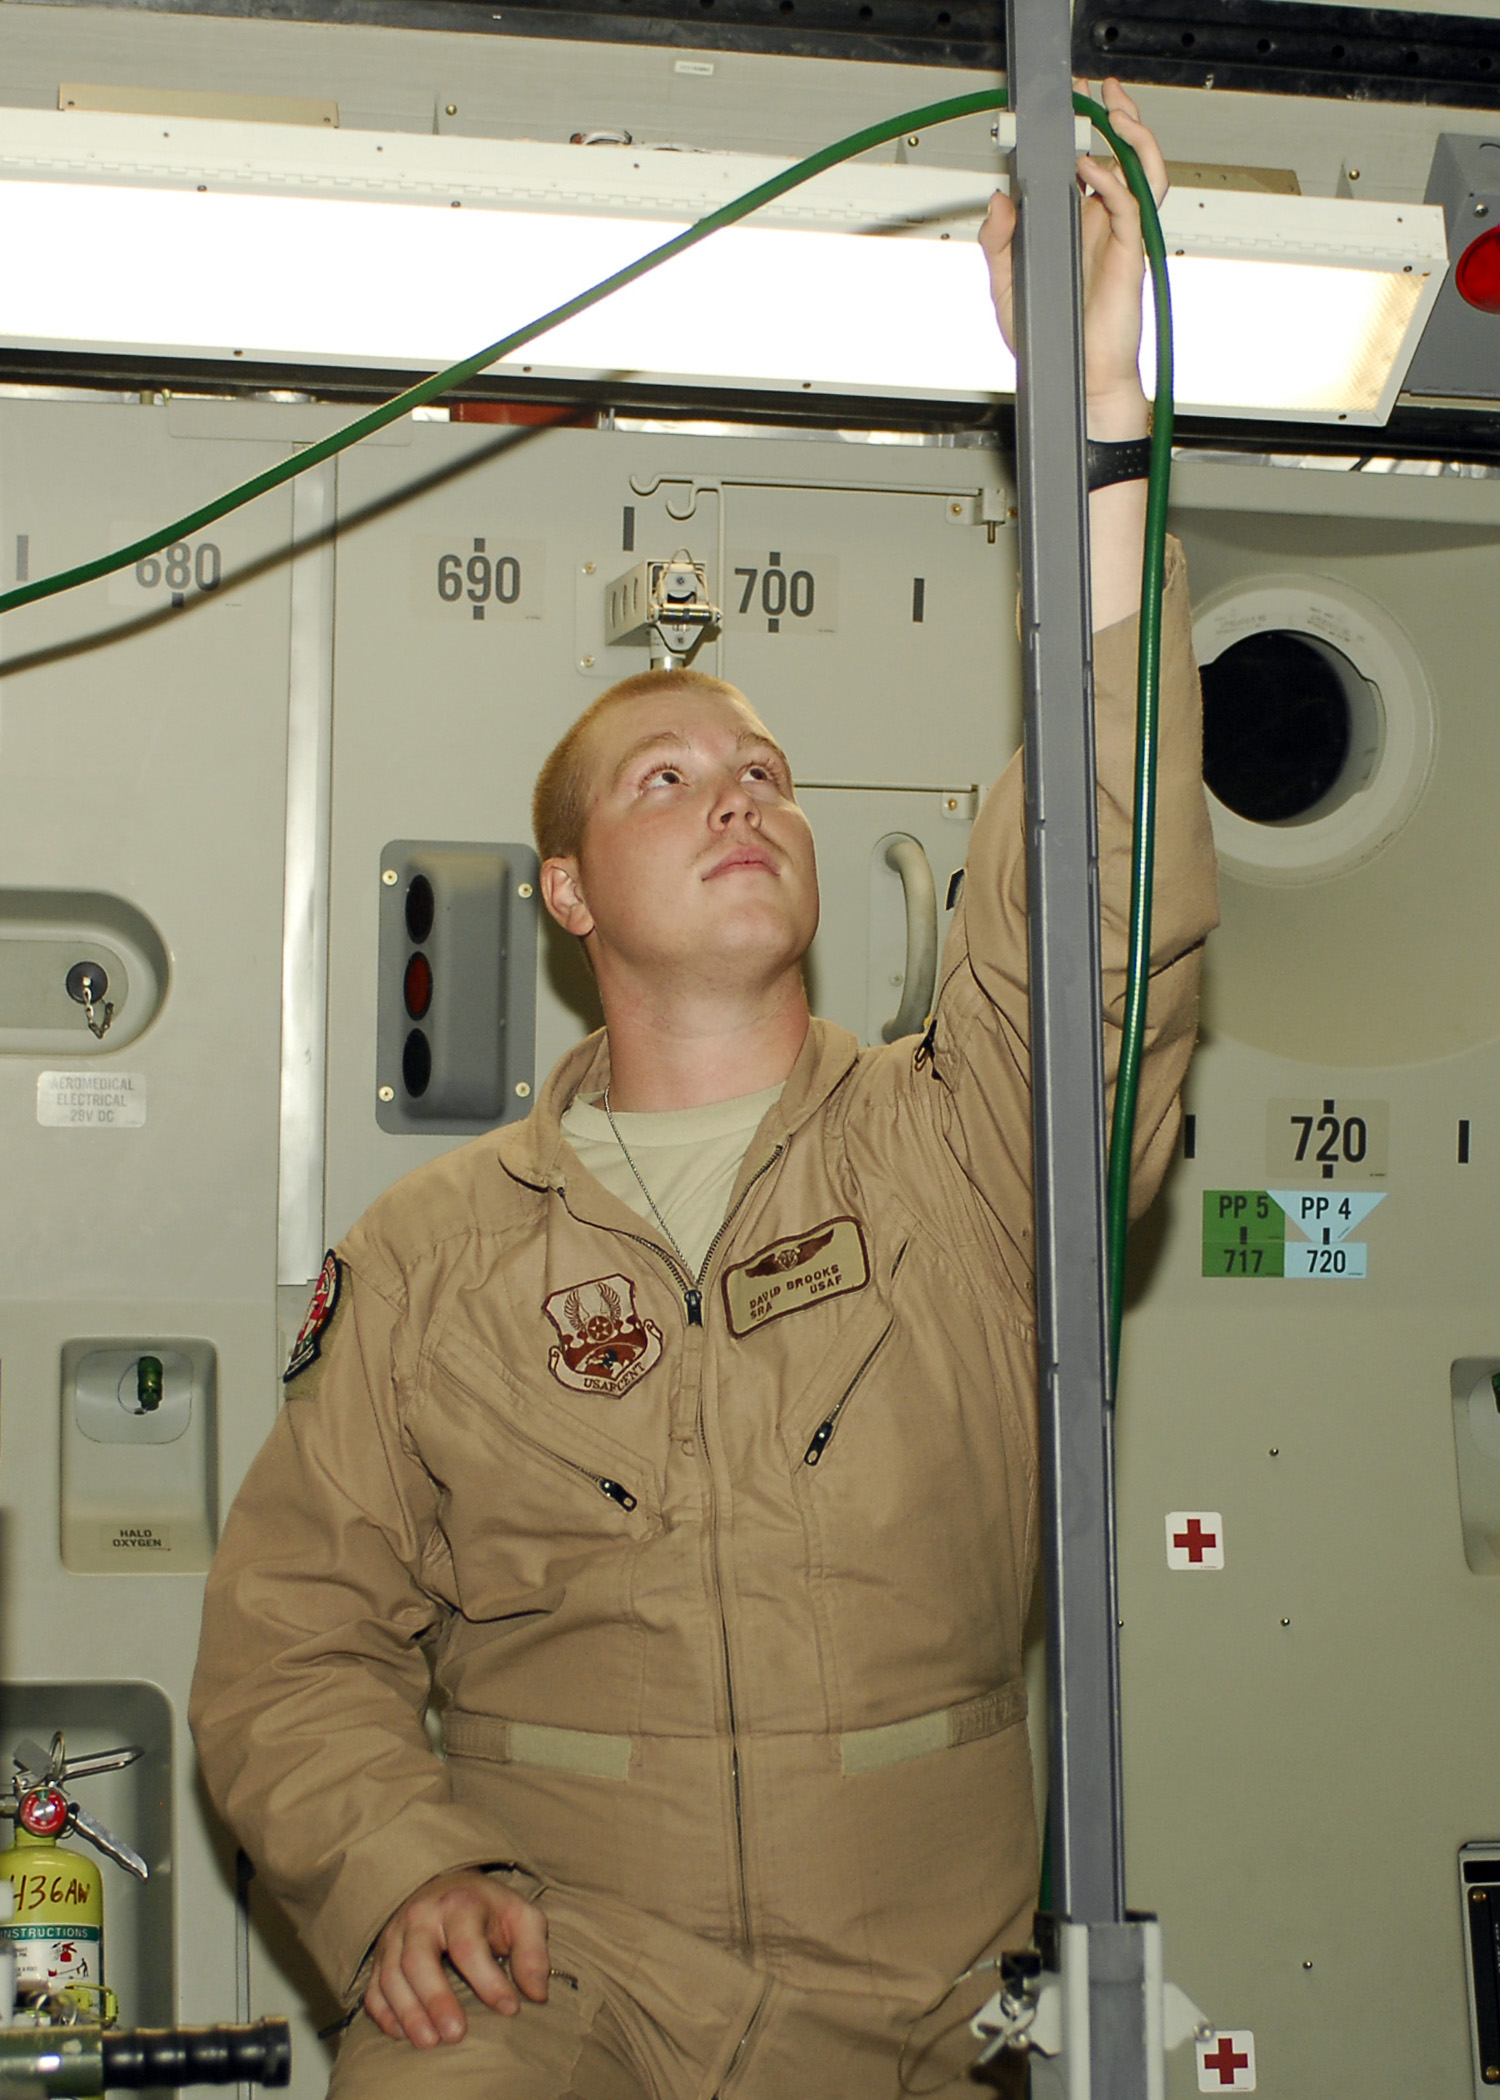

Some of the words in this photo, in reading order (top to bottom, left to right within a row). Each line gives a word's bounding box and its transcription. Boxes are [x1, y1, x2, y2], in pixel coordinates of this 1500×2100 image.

[135, 542, 221, 591] 680
[438, 554, 521, 604] 690
[734, 567, 815, 618] 700
[51, 1077, 135, 1091] AEROMEDICAL
[57, 1093, 127, 1107] ELECTRICAL
[70, 1110, 94, 1122] 28V
[98, 1110, 114, 1123] DC
[1290, 1115, 1367, 1163] 720
[1219, 1195, 1247, 1219] PP
[1256, 1196, 1269, 1219] 5
[1301, 1197, 1329, 1220] PP
[1338, 1197, 1352, 1220] 4
[1223, 1249, 1264, 1273] 717
[1306, 1250, 1346, 1273] 720
[750, 1286, 781, 1309] DAVID
[786, 1264, 840, 1291] BROOKS
[750, 1303, 773, 1320] SRA
[810, 1274, 843, 1294] USAF
[583, 1362, 646, 1393] USAFCENT
[112, 1539, 162, 1547] OXYGEN
[120, 1529, 152, 1538] HALO
[0, 1926, 88, 1938] INSTRUCTIONS
